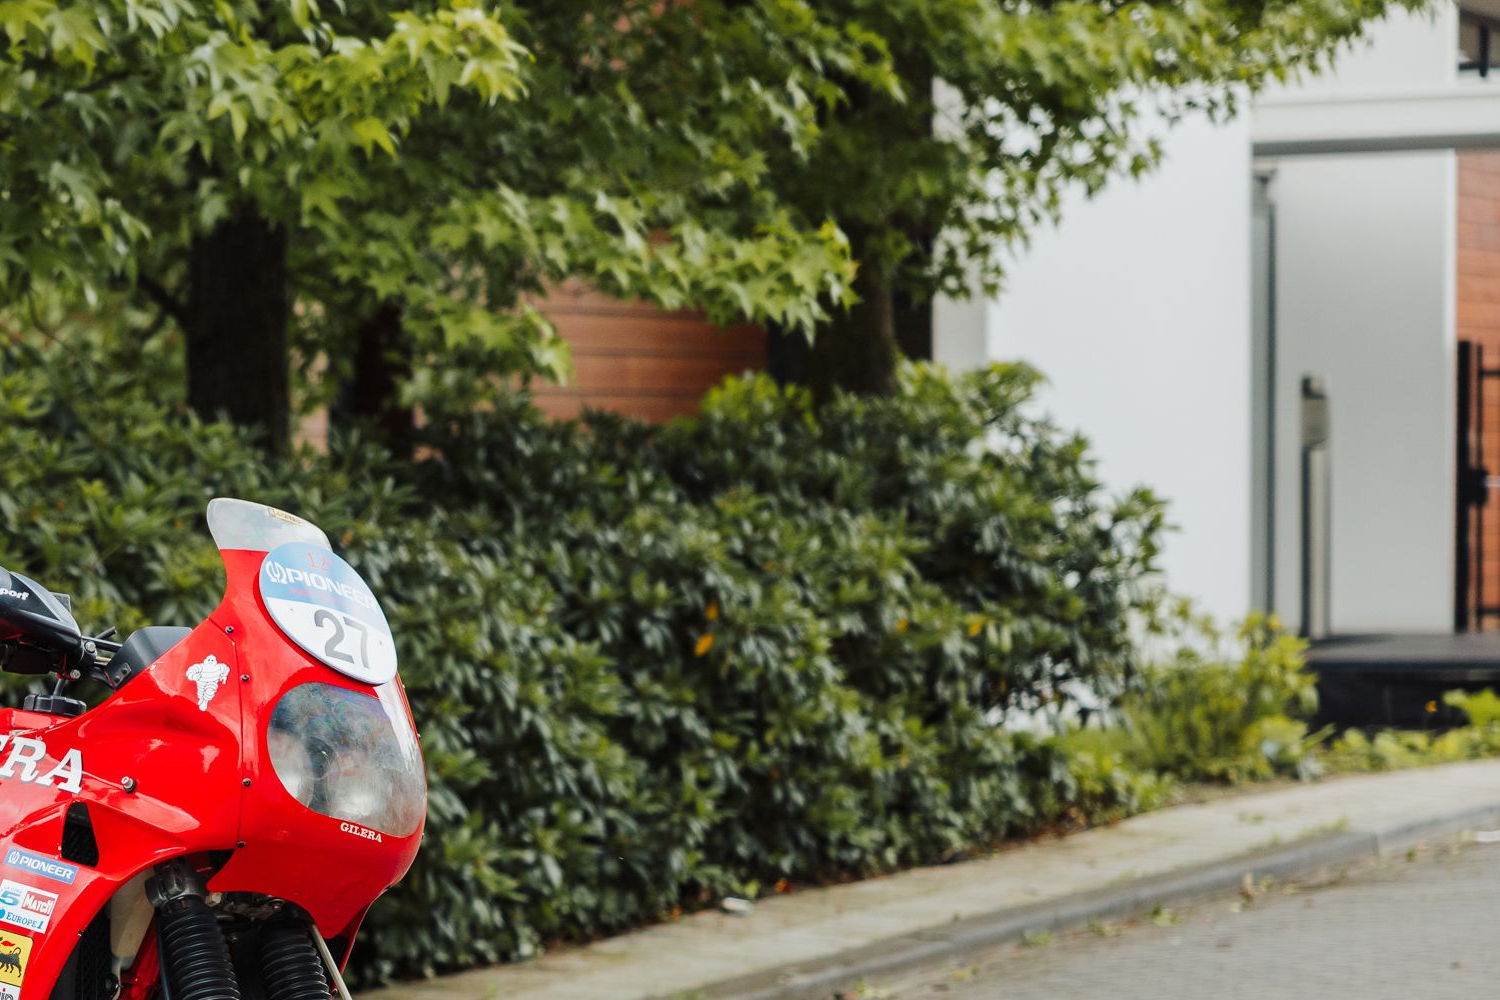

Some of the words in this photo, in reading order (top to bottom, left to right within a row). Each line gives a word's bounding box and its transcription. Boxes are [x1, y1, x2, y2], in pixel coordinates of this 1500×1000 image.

[287, 567, 379, 613] PIONEER
[314, 609, 370, 669] 27
[340, 822, 382, 843] GILERA
[19, 855, 75, 880] PIONEER
[0, 890, 21, 906] 5
